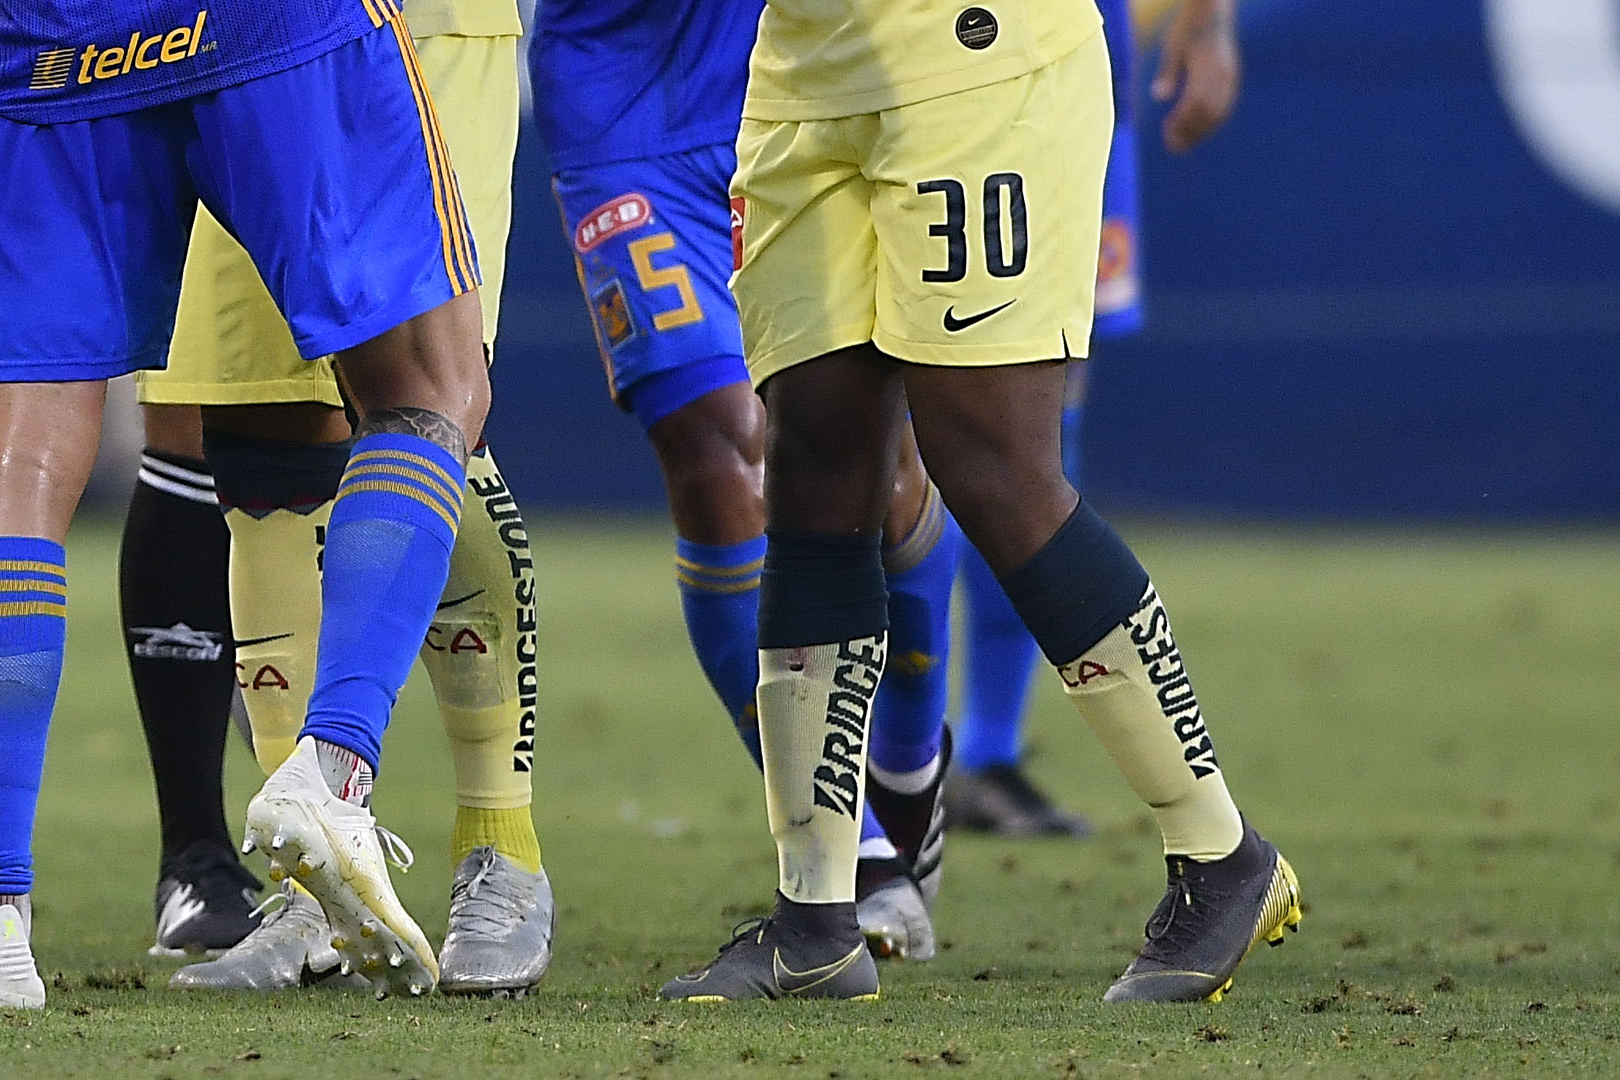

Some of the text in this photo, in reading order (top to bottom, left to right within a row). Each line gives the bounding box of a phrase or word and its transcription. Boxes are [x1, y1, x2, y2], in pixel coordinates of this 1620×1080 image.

[77, 10, 207, 85] telcel
[917, 172, 1028, 283] 30
[627, 232, 704, 332] 5
[1056, 660, 1109, 688] CA
